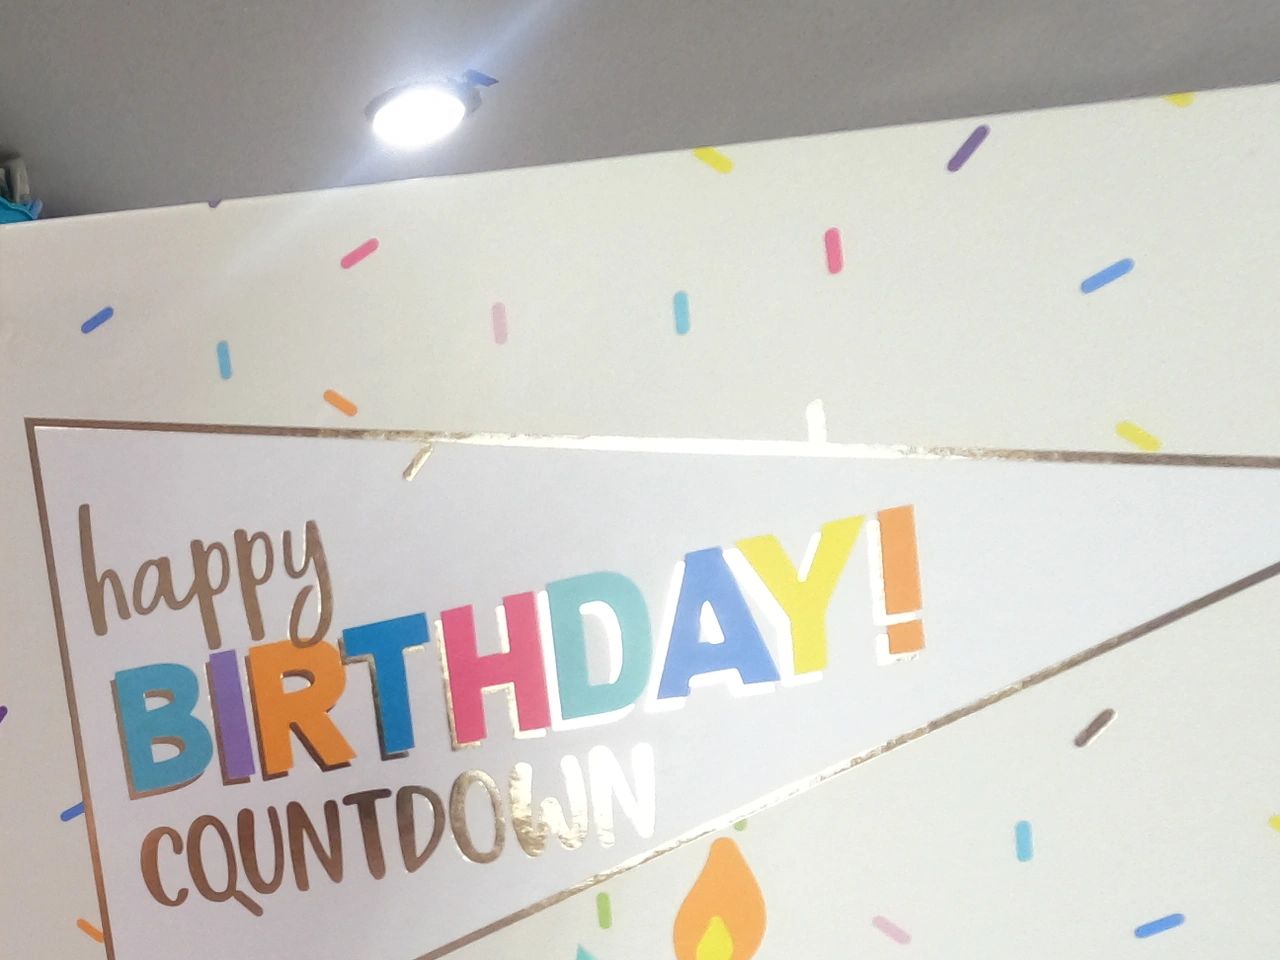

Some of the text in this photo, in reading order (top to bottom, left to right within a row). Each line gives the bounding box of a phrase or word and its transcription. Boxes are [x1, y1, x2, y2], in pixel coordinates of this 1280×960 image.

[79, 504, 332, 648] happy
[113, 504, 926, 800] BIRTHDAY!
[140, 742, 656, 918] COUNTDOWN
